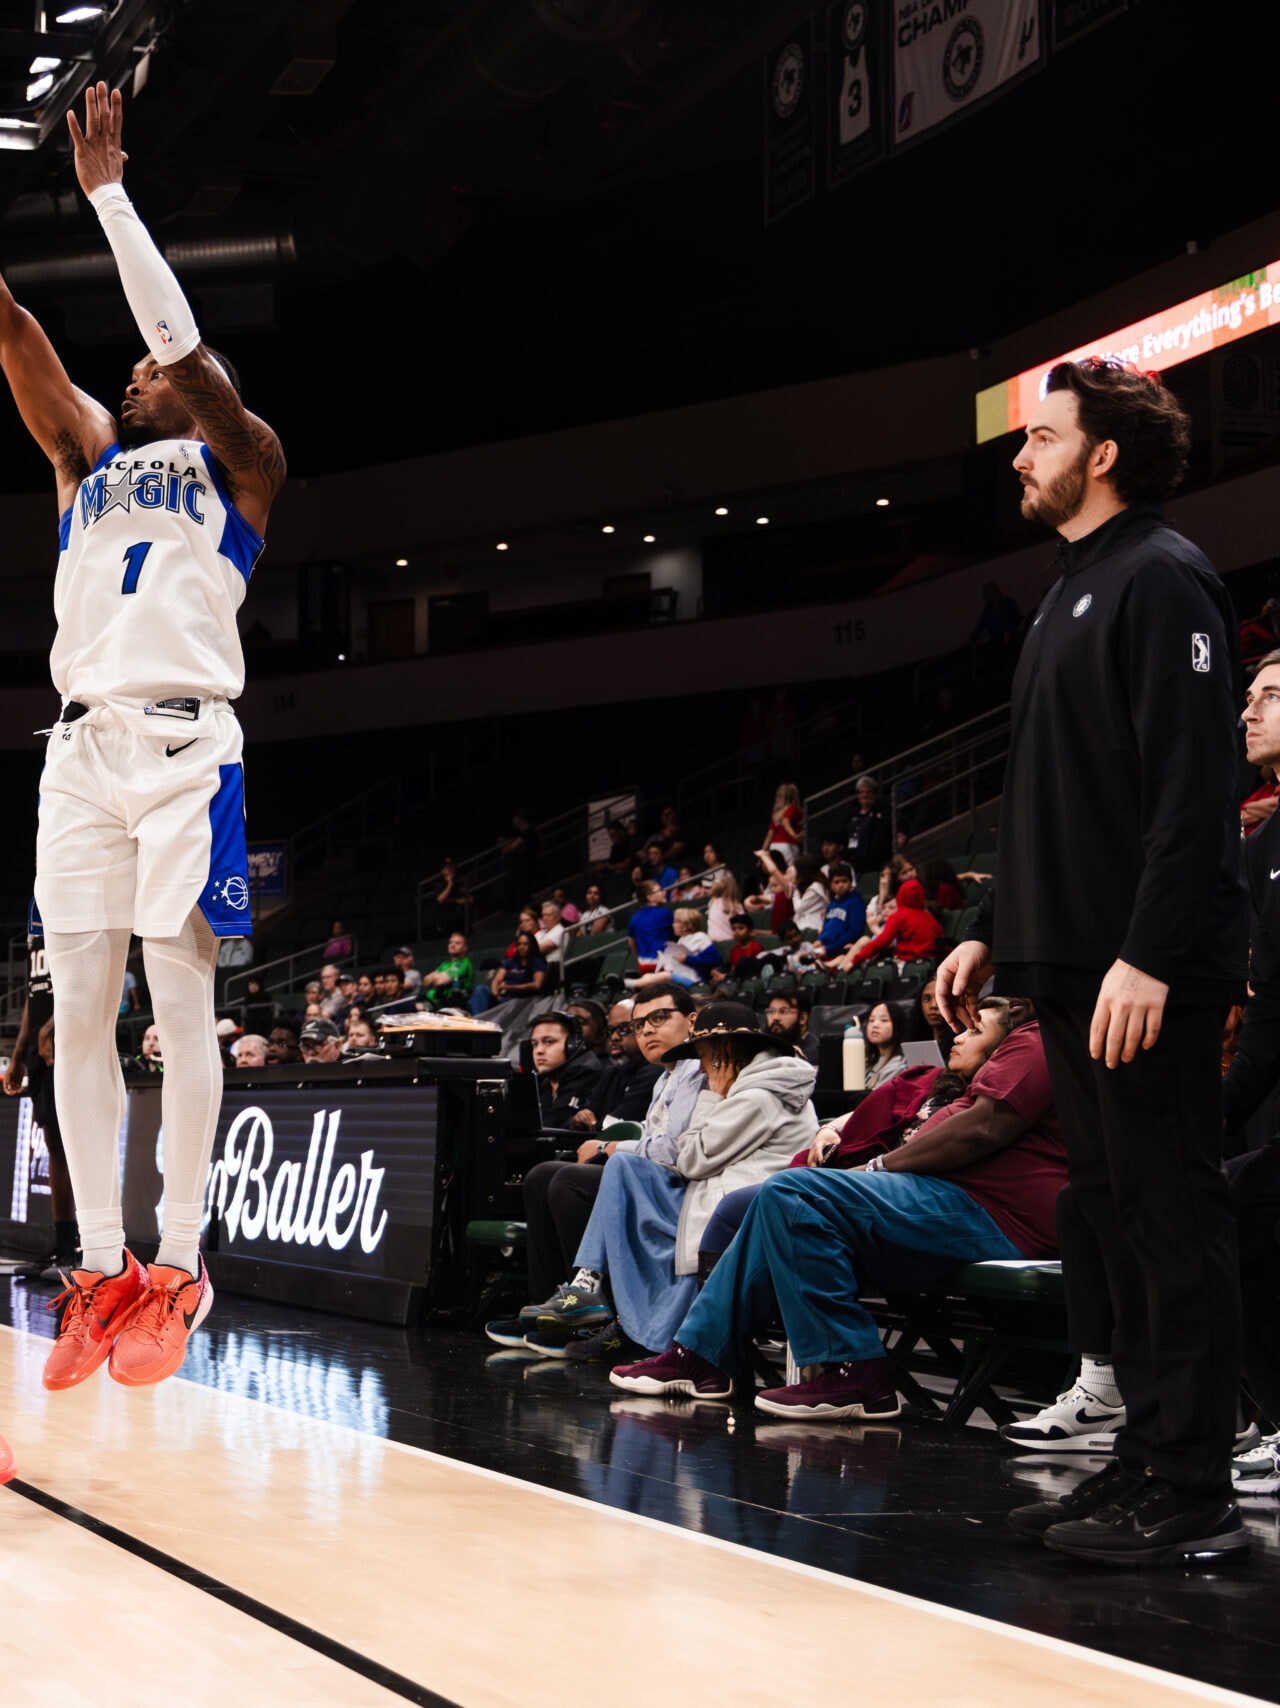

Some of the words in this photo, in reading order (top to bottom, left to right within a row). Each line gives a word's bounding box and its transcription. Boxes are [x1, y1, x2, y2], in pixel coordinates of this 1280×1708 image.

[848, 79, 862, 117] 3
[1142, 291, 1256, 359] Everything's
[122, 541, 153, 595] 1
[834, 619, 865, 645] 115
[272, 694, 297, 713] 114
[155, 1105, 388, 1255] oBaller
